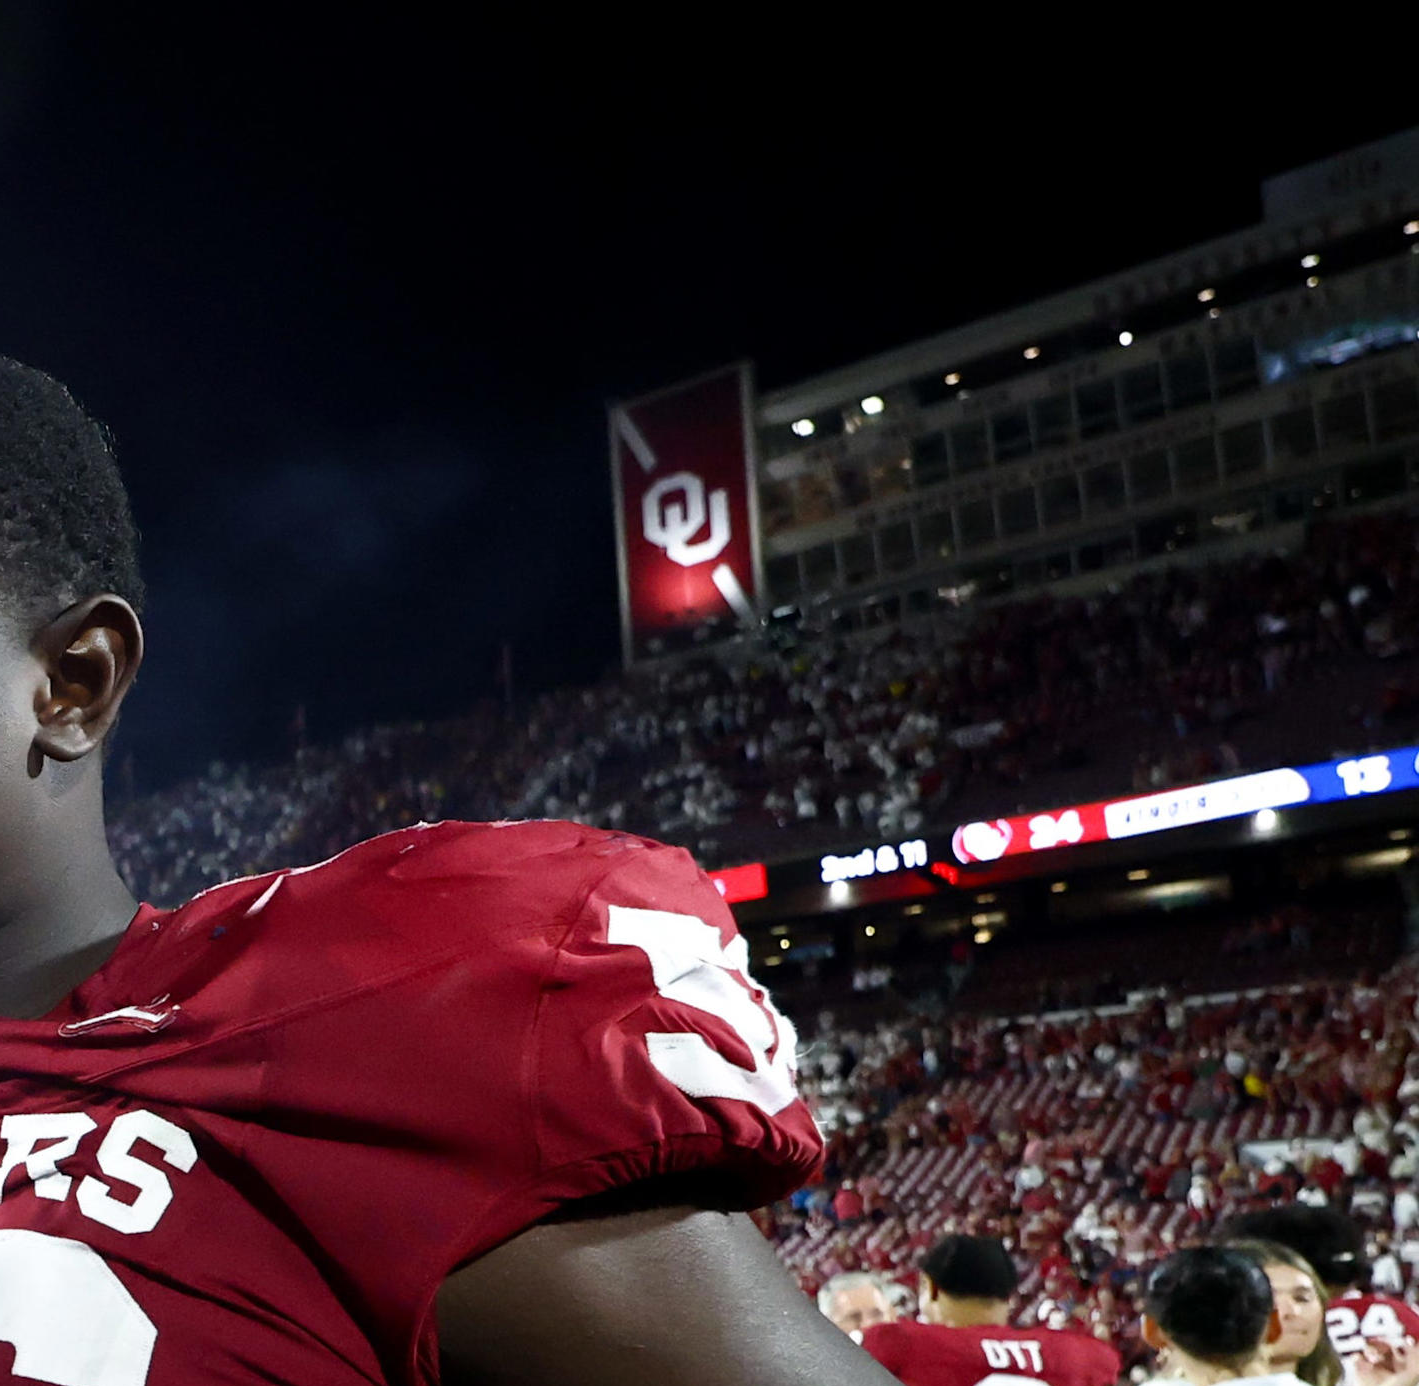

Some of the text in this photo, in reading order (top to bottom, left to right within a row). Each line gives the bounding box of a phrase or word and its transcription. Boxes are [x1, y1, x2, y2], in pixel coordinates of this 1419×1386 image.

[642, 471, 731, 567] OU
[1029, 810, 1083, 849] 24
[821, 848, 874, 883] 2nd
[1325, 1303, 1406, 1354] 24
[980, 1338, 1044, 1373] OTT
